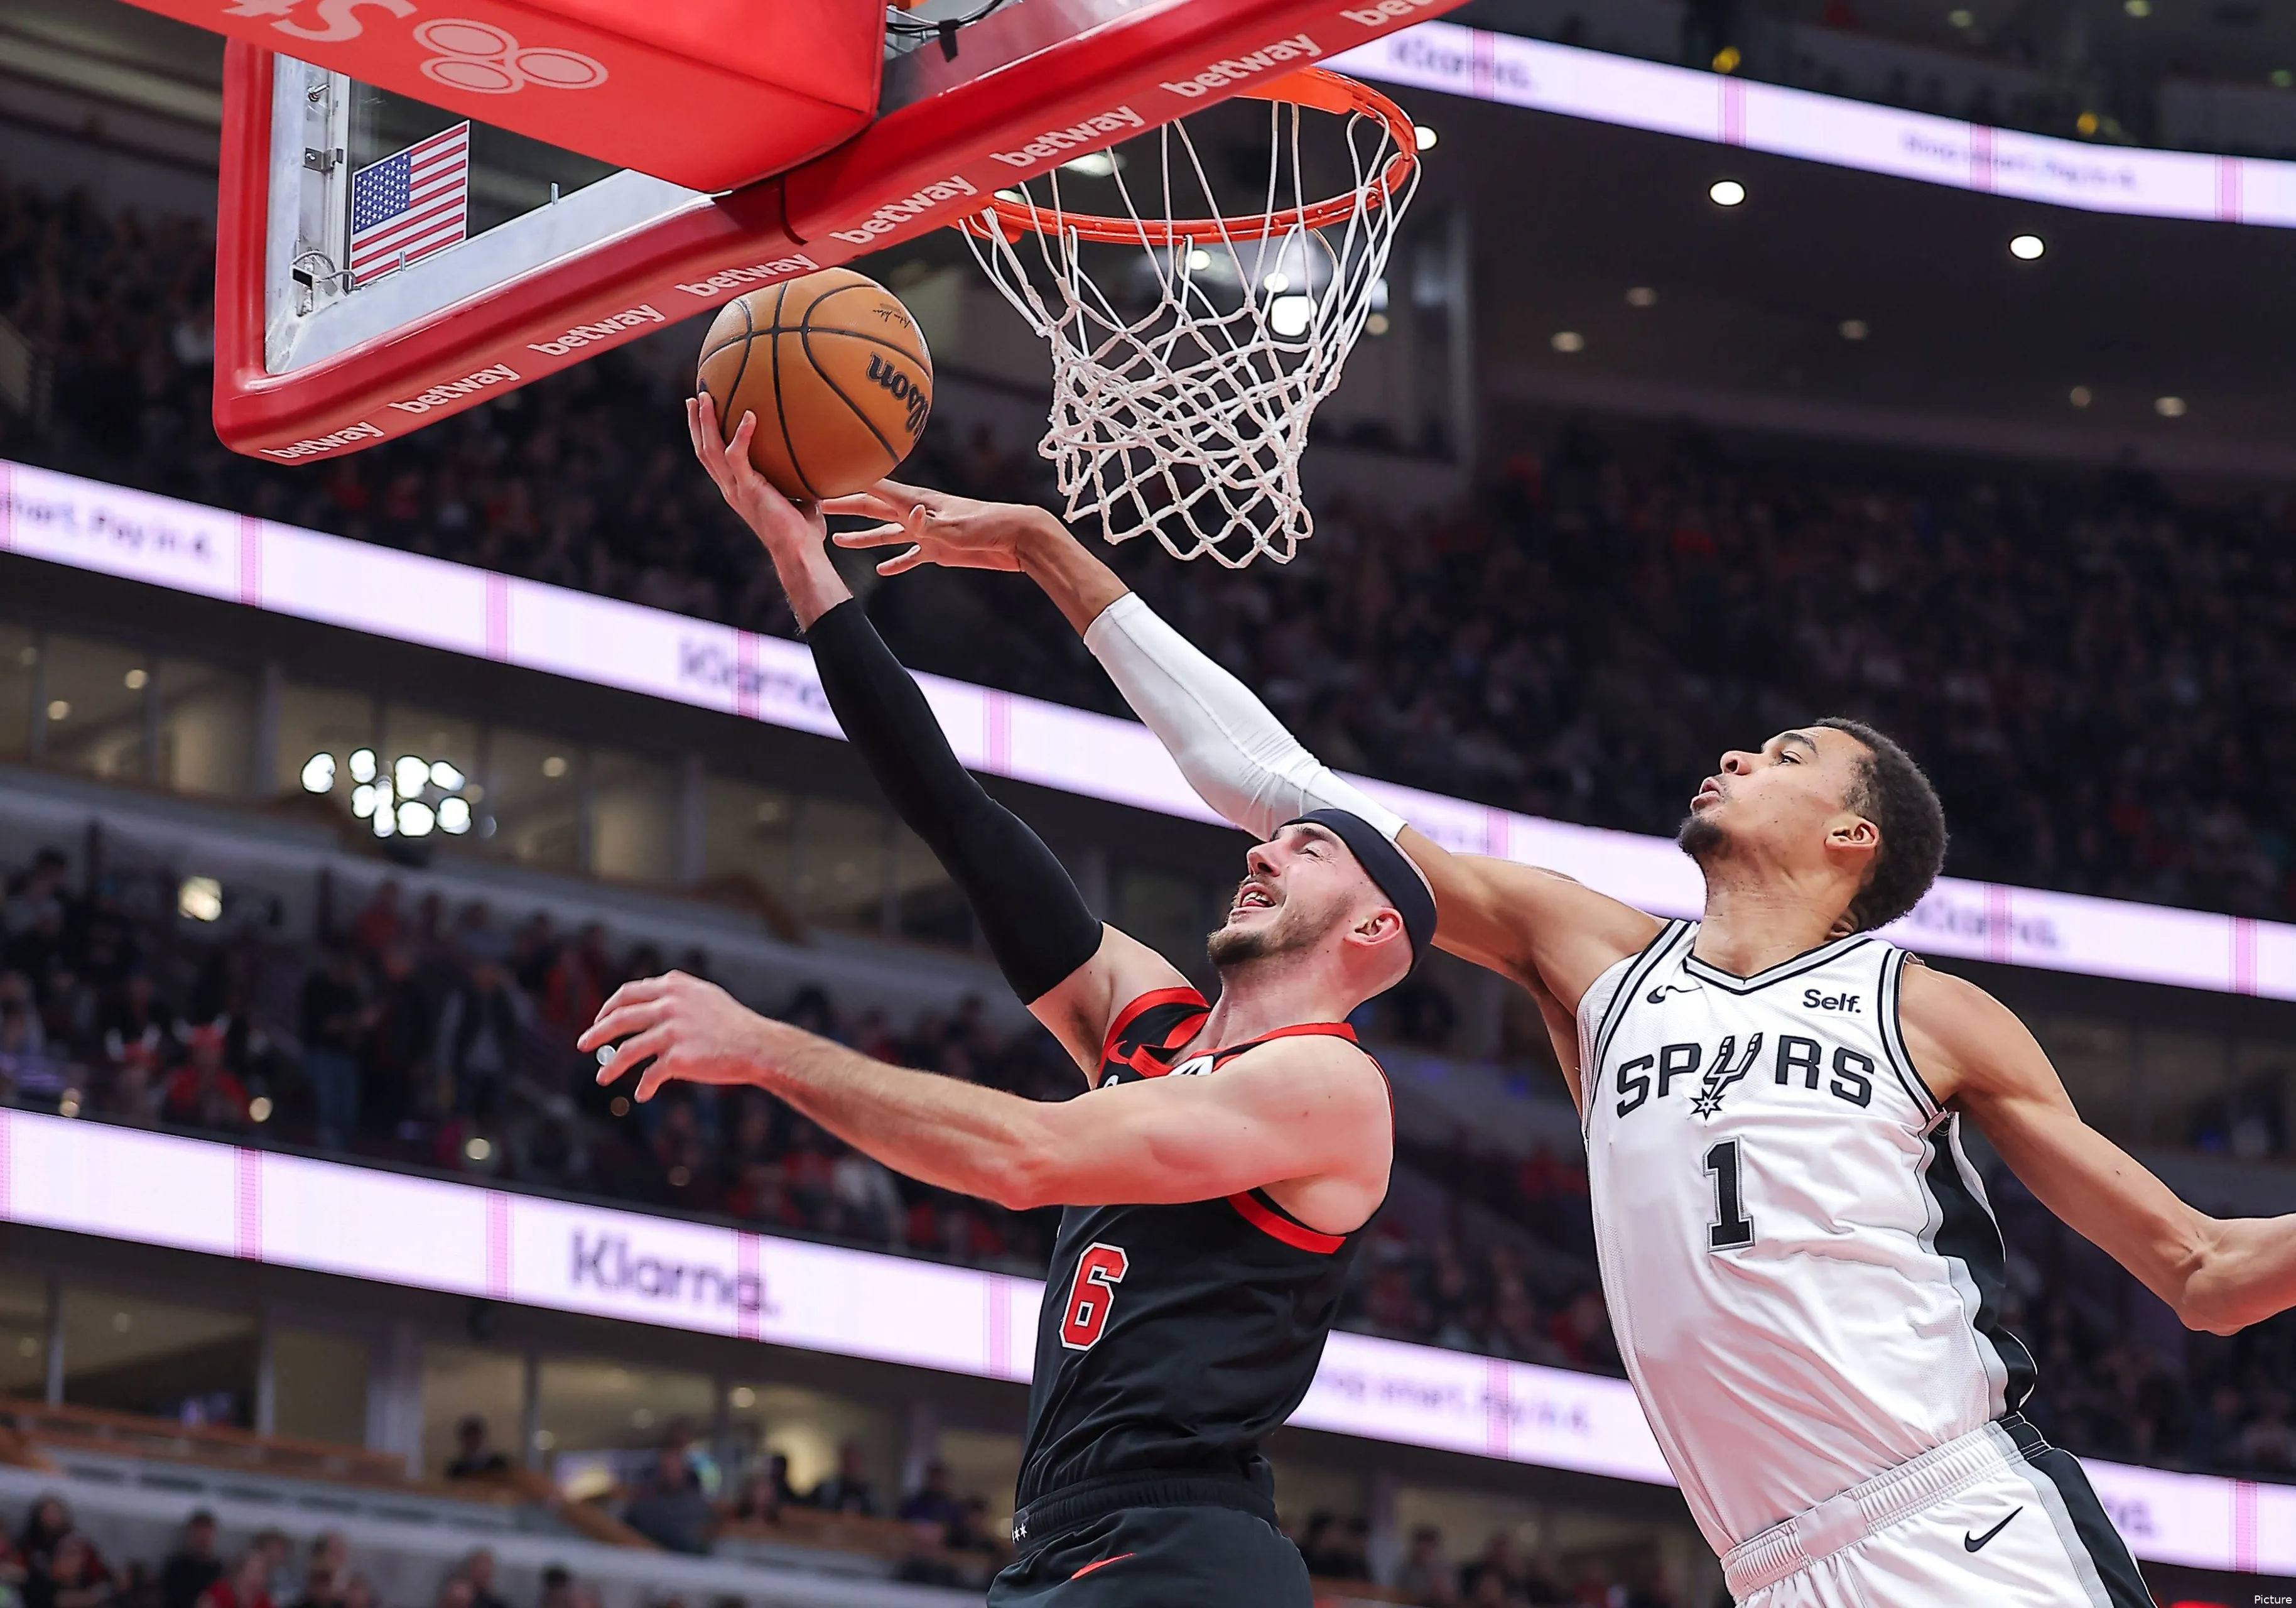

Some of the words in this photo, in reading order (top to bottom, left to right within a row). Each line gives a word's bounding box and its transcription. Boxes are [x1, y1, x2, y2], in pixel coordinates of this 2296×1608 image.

[1159, 33, 1322, 97] betway
[989, 105, 1145, 167] betway
[829, 175, 978, 244] betway
[674, 253, 820, 297] betway
[527, 303, 666, 356] betway
[387, 362, 521, 413] betway
[259, 421, 384, 459] betway
[1802, 989, 1861, 1013] Self.
[1616, 1032, 1875, 1120] SPURS
[1703, 1136, 1755, 1251] 1
[1059, 1242, 1129, 1350] 6
